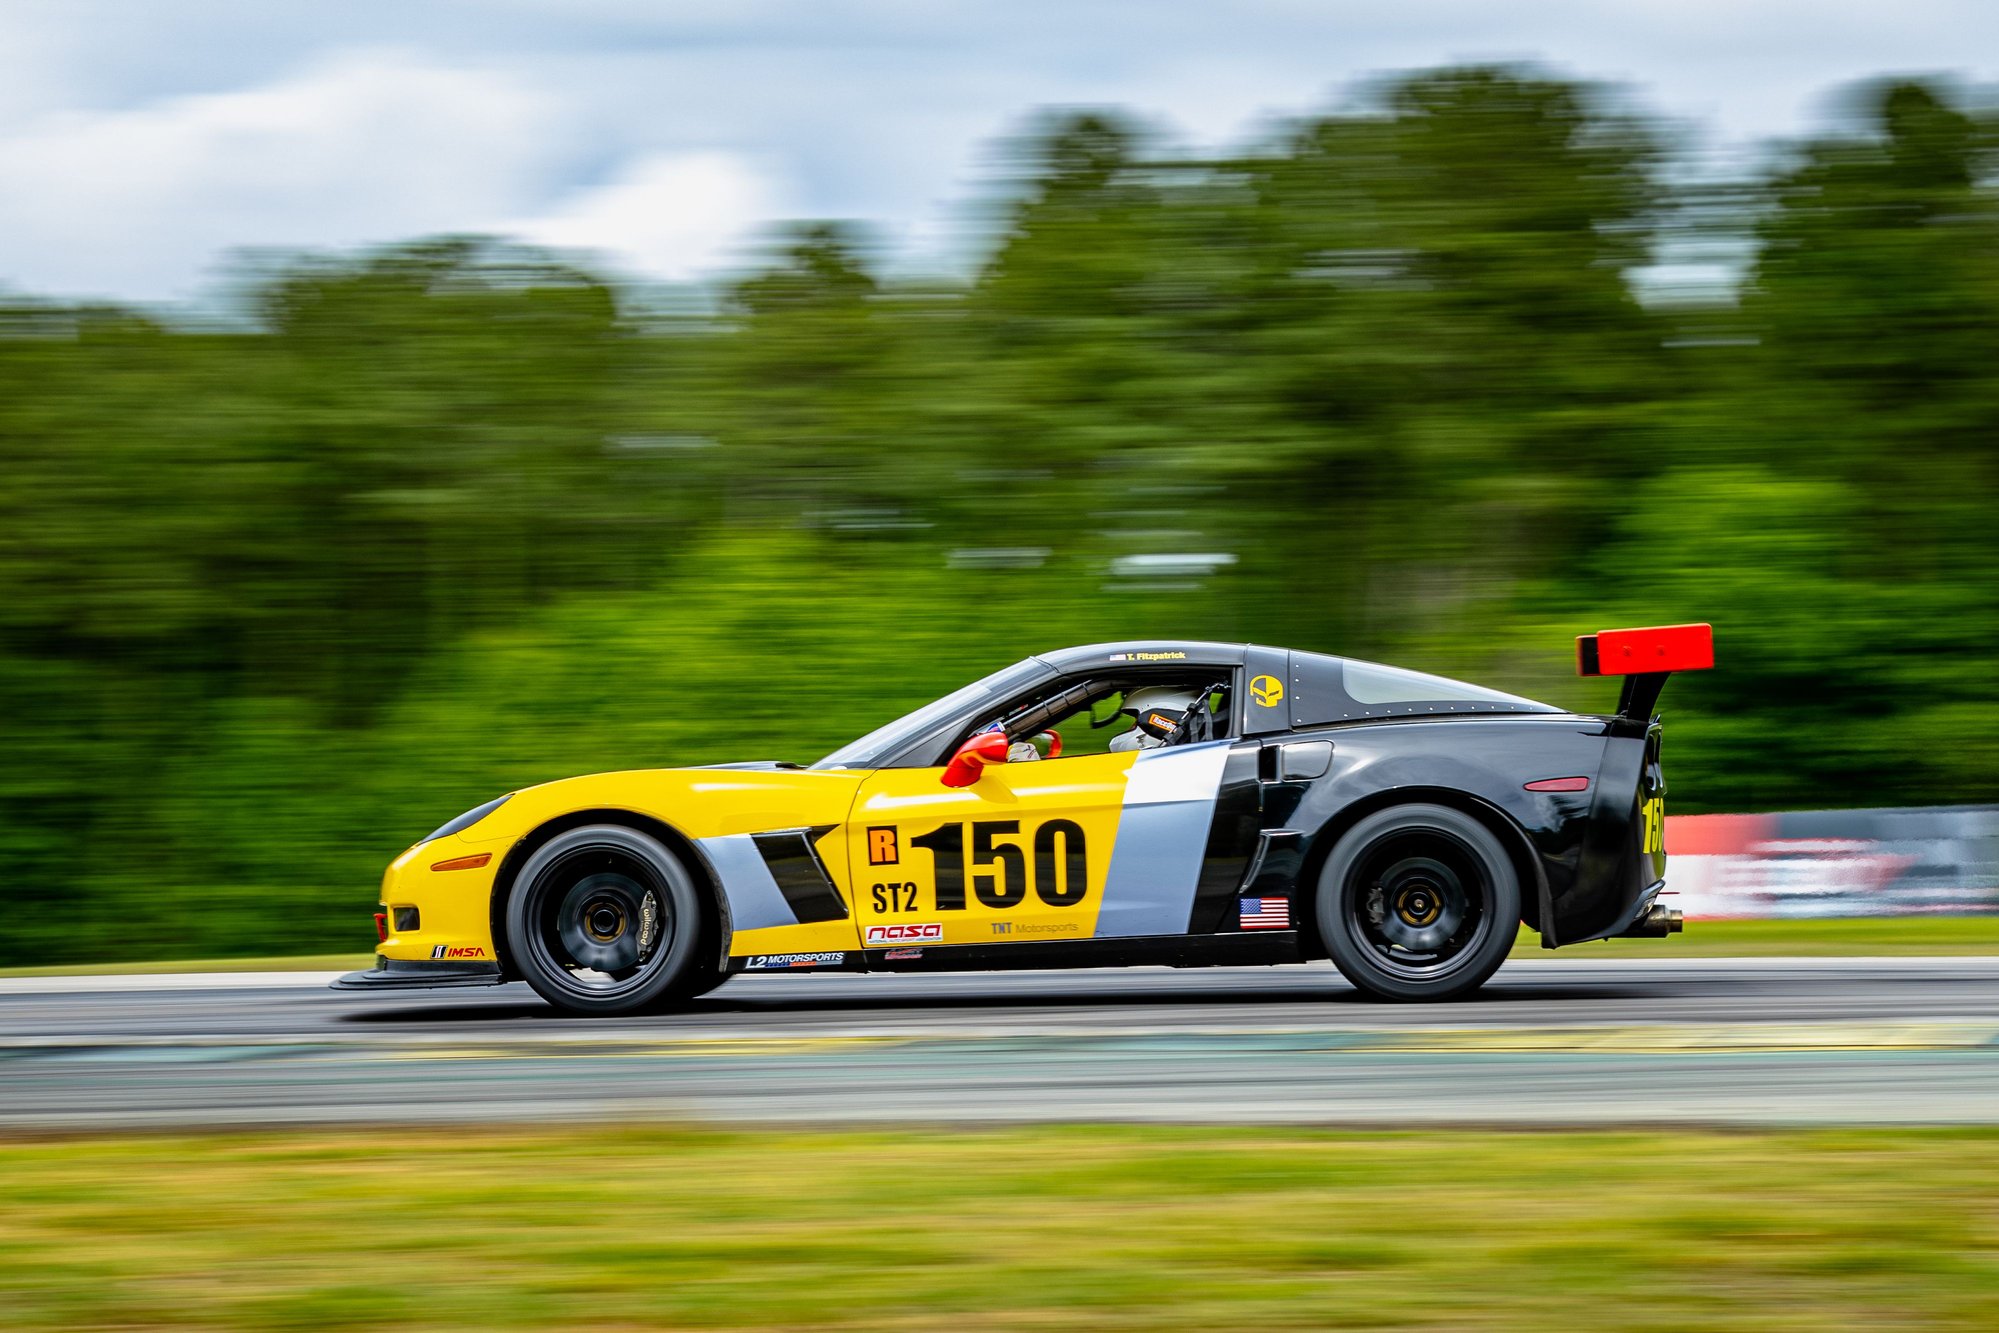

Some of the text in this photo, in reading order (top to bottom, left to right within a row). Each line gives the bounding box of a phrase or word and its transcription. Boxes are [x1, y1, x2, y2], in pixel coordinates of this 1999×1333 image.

[1126, 651, 1186, 661] T. Fitzpatrick
[869, 829, 897, 863] R
[910, 818, 1088, 911] 150
[872, 881, 918, 914] ST2
[640, 908, 652, 946] wilwood
[991, 922, 1080, 935] TNT Motorsports
[447, 946, 486, 958] IMSA
[744, 956, 768, 969] L2
[767, 951, 845, 964] MOTORSPORTS
